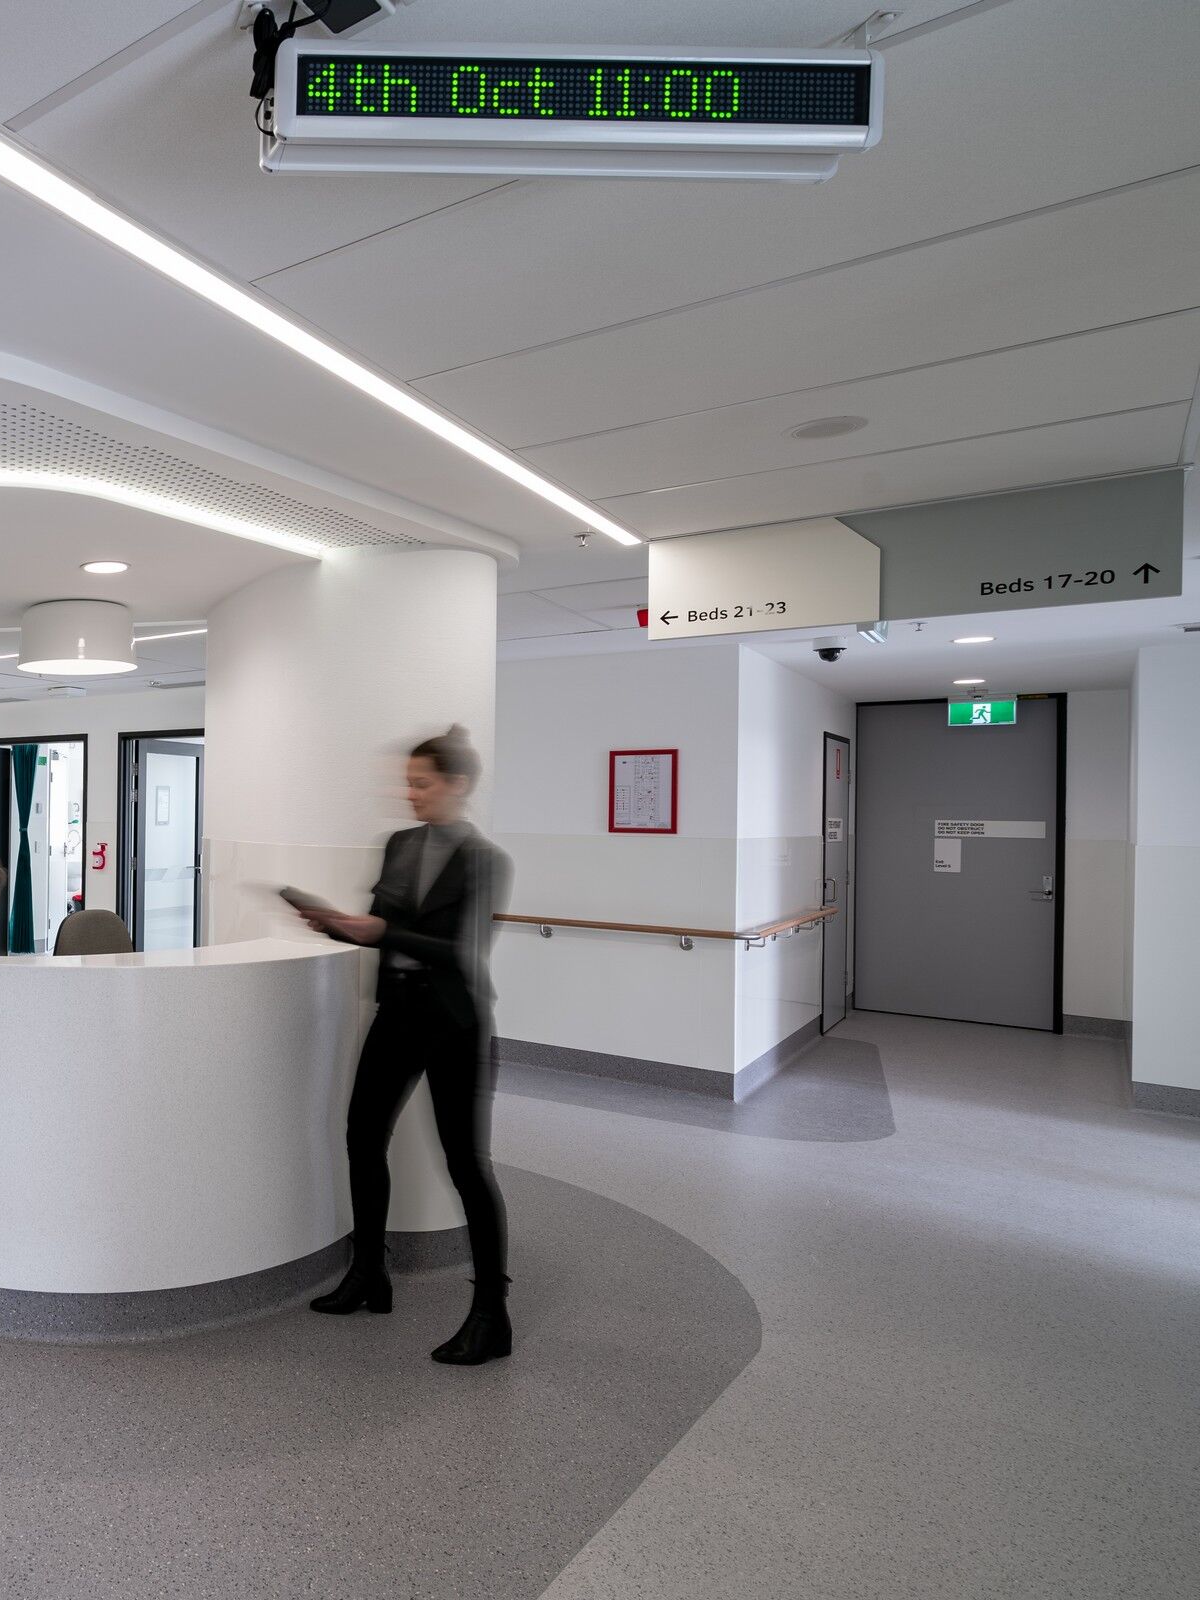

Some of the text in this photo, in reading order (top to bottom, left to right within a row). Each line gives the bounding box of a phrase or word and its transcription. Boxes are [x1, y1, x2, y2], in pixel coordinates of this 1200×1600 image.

[308, 63, 740, 118] 4th Oct 11:00
[980, 569, 1116, 596] Beds 17-20
[688, 601, 787, 622] Beds 21-23
